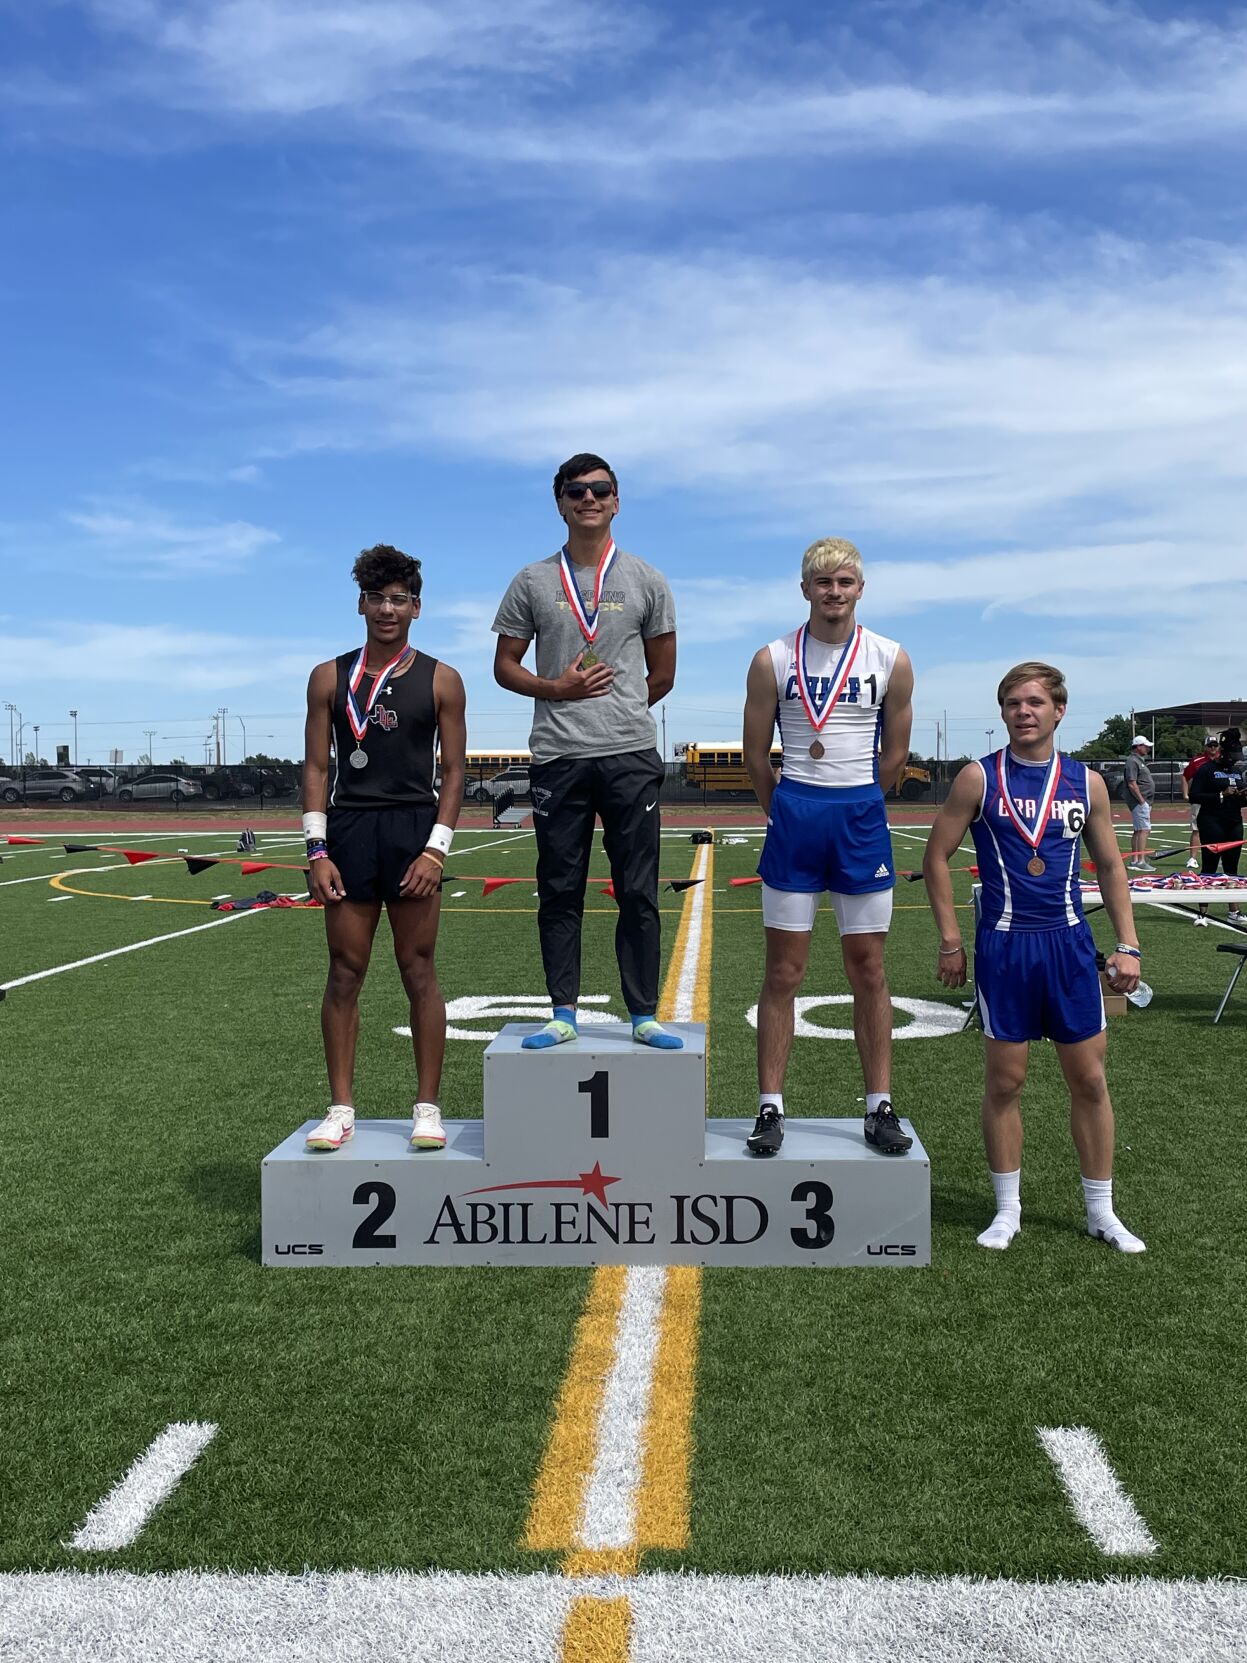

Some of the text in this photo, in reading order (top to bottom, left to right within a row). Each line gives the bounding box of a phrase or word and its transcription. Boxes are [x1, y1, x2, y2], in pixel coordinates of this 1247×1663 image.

[580, 590, 626, 603] SPING
[864, 673, 877, 704] 1
[1067, 807, 1084, 833] 6
[577, 1071, 610, 1139] 1
[351, 1181, 397, 1249] 2
[423, 1193, 769, 1245] ABILENE ISD
[789, 1180, 836, 1250] 3
[274, 1243, 325, 1256] UCS
[866, 1244, 917, 1256] UCS
